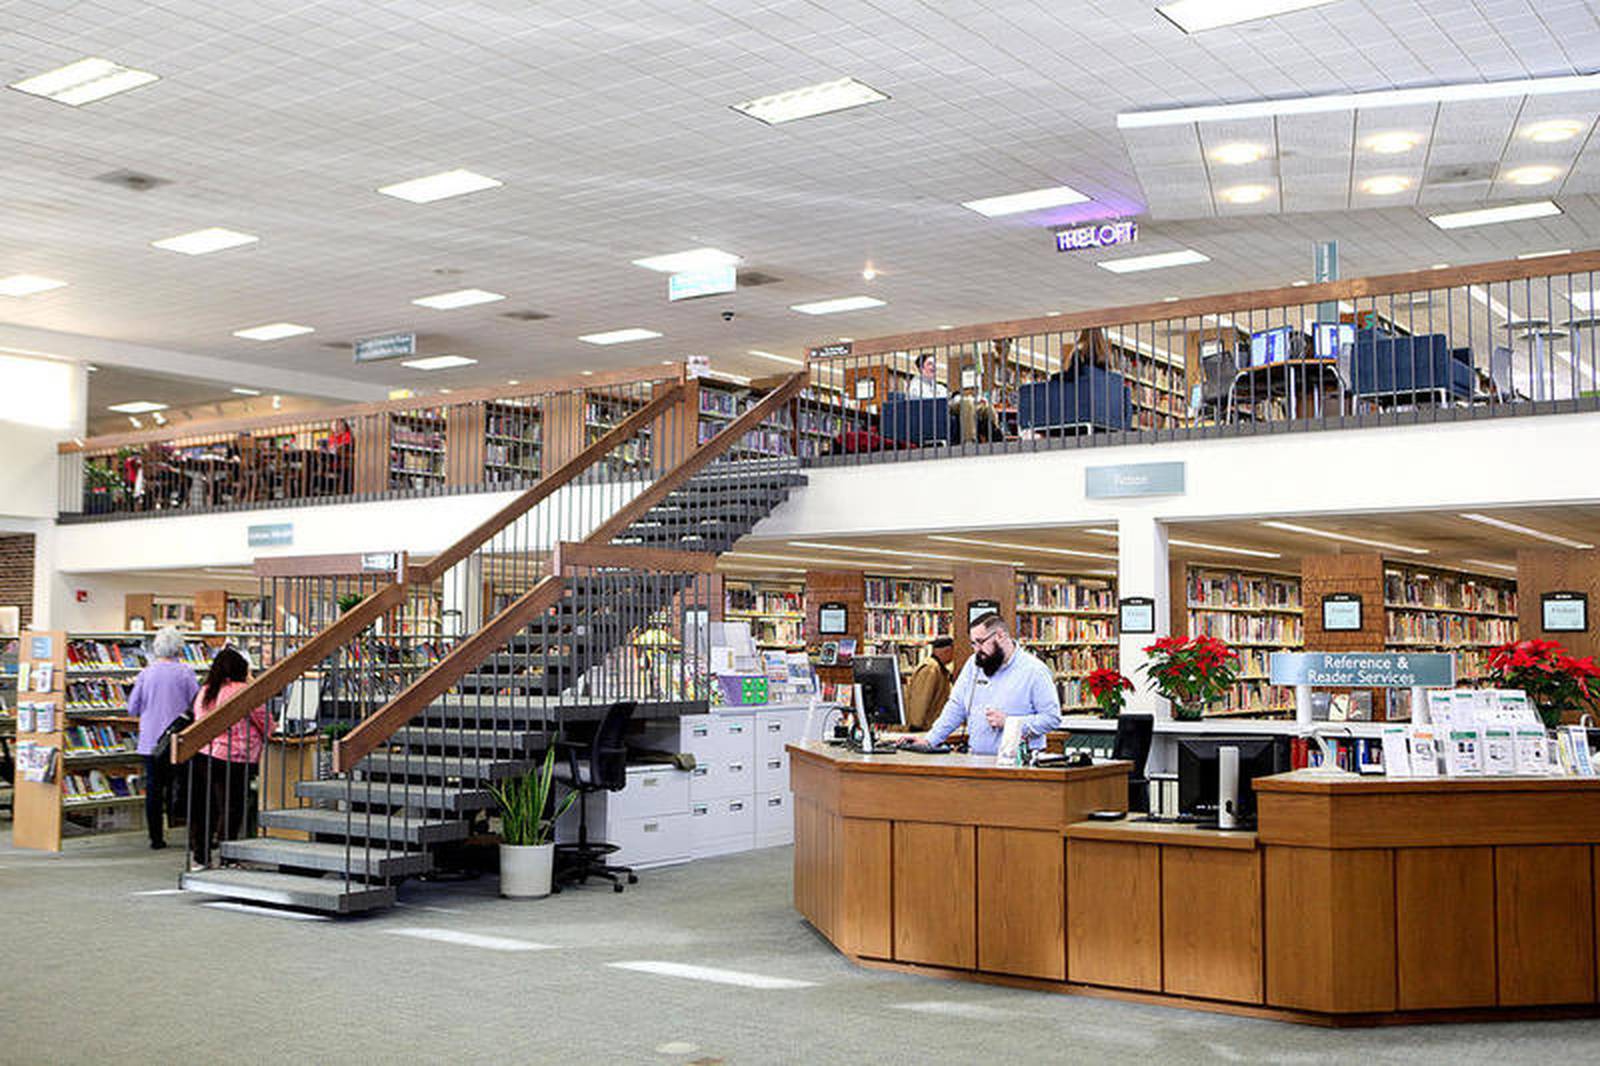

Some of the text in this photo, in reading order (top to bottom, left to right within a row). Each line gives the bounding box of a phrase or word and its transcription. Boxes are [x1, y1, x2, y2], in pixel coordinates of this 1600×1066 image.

[1090, 222, 1133, 246] LOFT
[1324, 655, 1409, 670] Reference &
[1307, 670, 1416, 685] Reader Services
